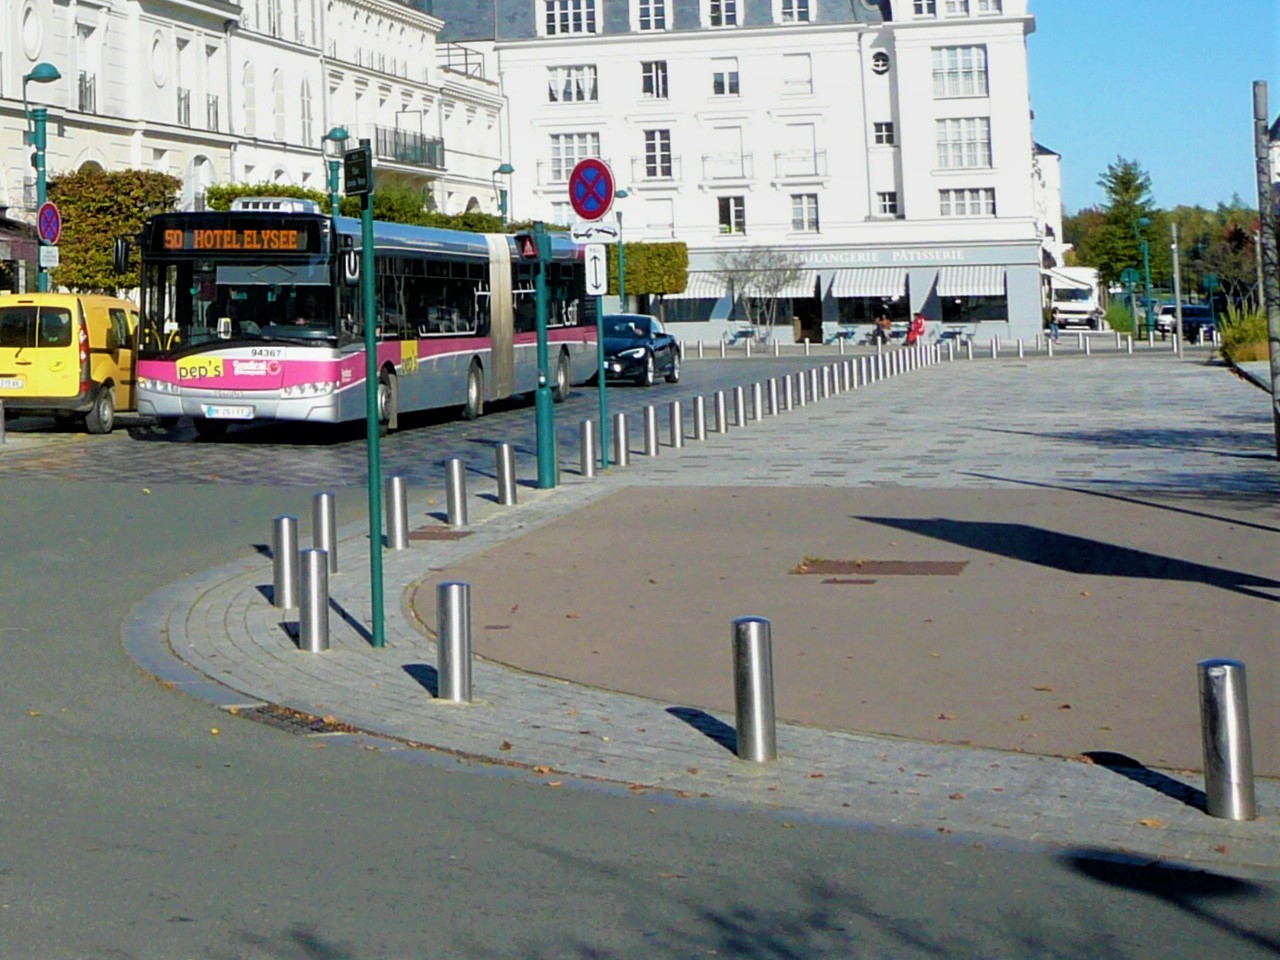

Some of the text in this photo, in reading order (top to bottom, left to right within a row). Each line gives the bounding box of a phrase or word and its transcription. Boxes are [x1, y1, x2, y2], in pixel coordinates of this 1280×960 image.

[164, 229, 298, 250] 50 HOTEL ELYSEE
[179, 361, 221, 380] pep's
